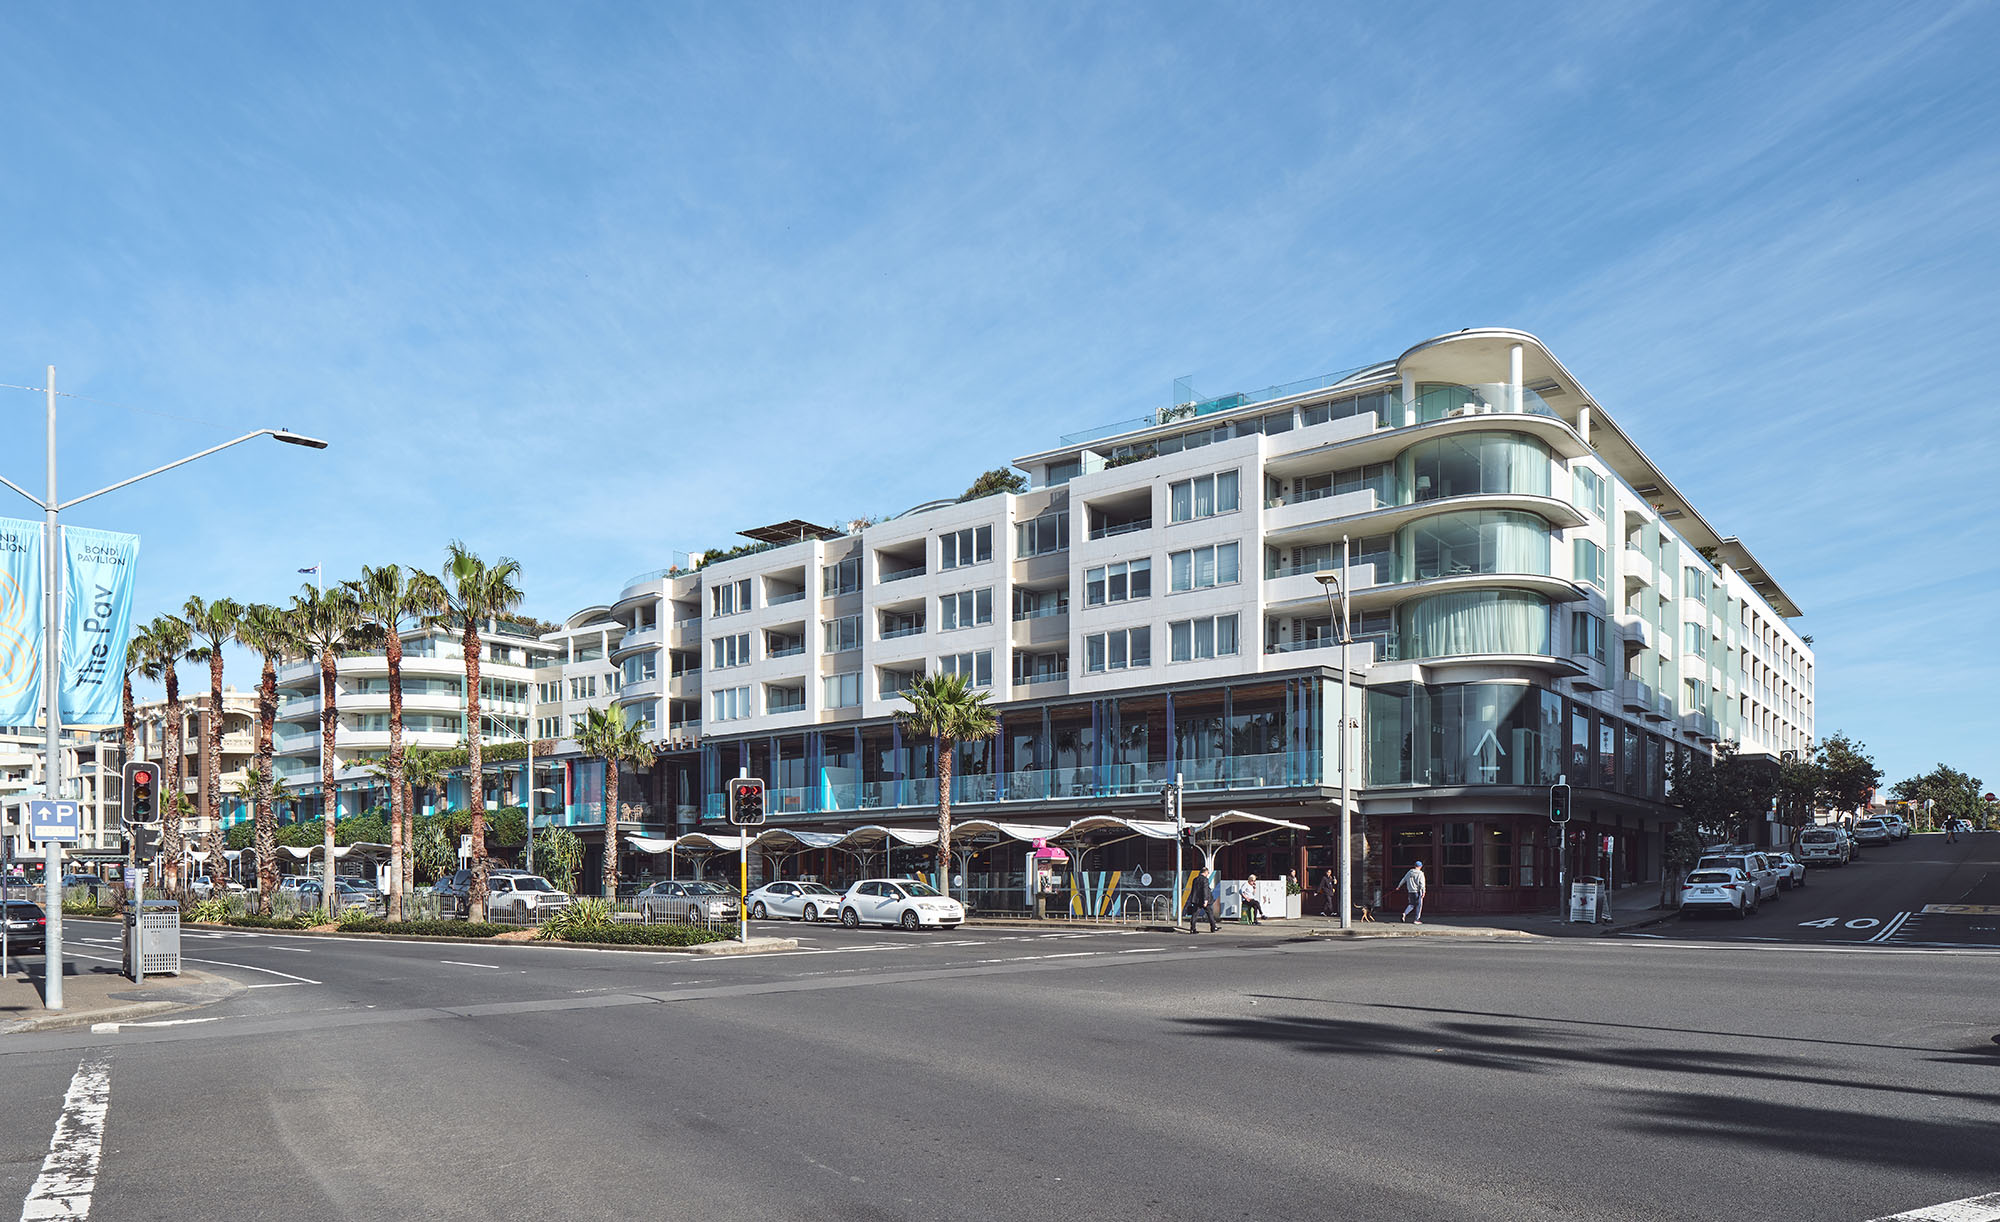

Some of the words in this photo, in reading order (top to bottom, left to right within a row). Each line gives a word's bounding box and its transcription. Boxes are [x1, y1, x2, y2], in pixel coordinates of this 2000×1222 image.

[0, 533, 19, 543] NDI
[0, 542, 27, 553] LION
[85, 545, 119, 556] BONDI
[77, 553, 126, 566] PAVILION
[76, 643, 108, 687] The
[56, 804, 74, 823] P
[1798, 917, 1880, 929] 40
